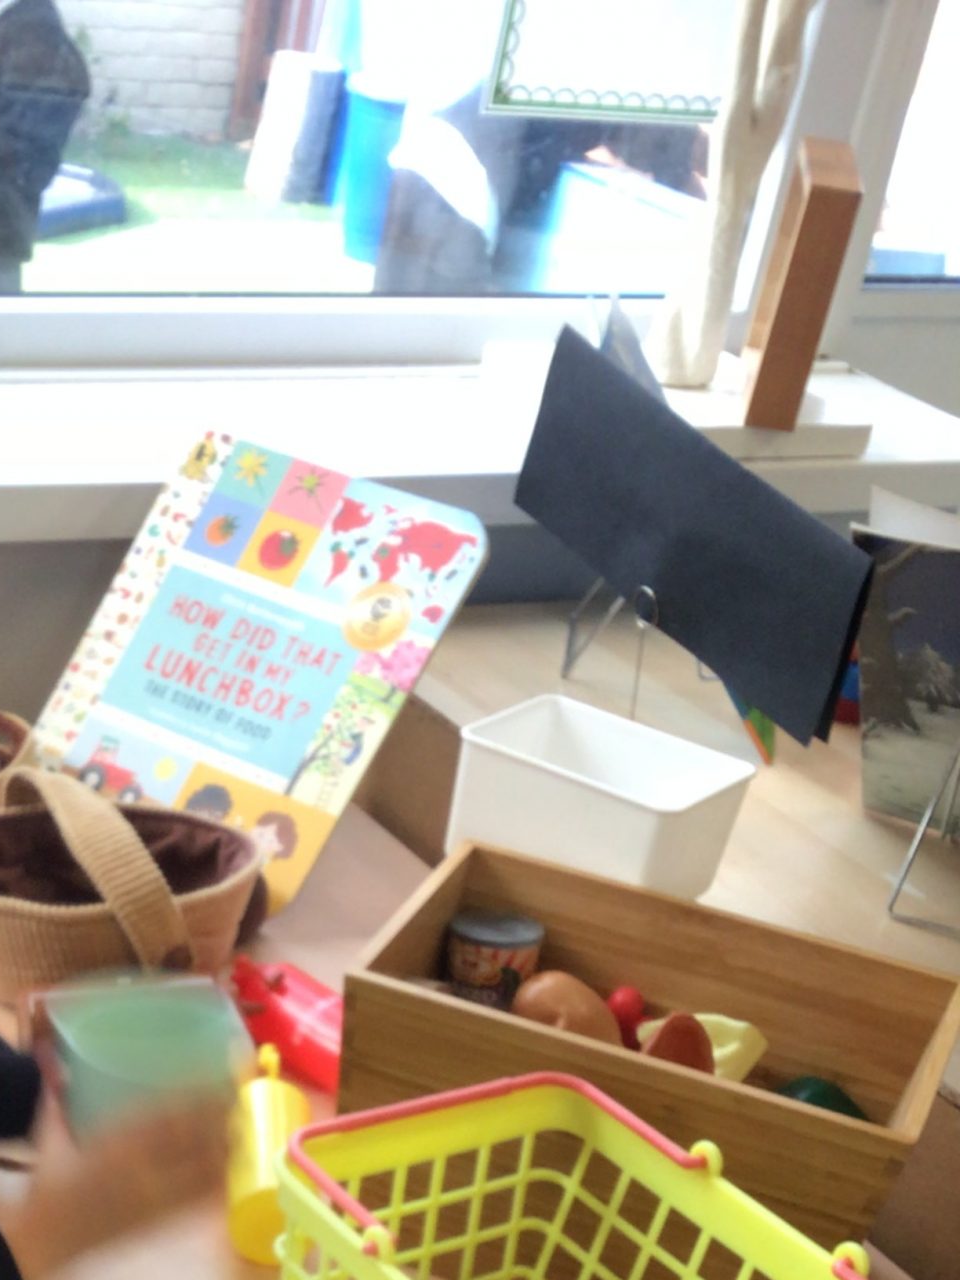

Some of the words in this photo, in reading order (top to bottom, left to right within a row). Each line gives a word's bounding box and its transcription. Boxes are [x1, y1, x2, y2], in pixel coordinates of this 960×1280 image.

[169, 594, 226, 630] HOW
[229, 617, 277, 651] DID
[283, 635, 344, 676] THAT
[192, 631, 233, 663] GET
[235, 651, 262, 674] IN
[263, 662, 296, 685] MY
[144, 643, 312, 721] LUNCHBOX?
